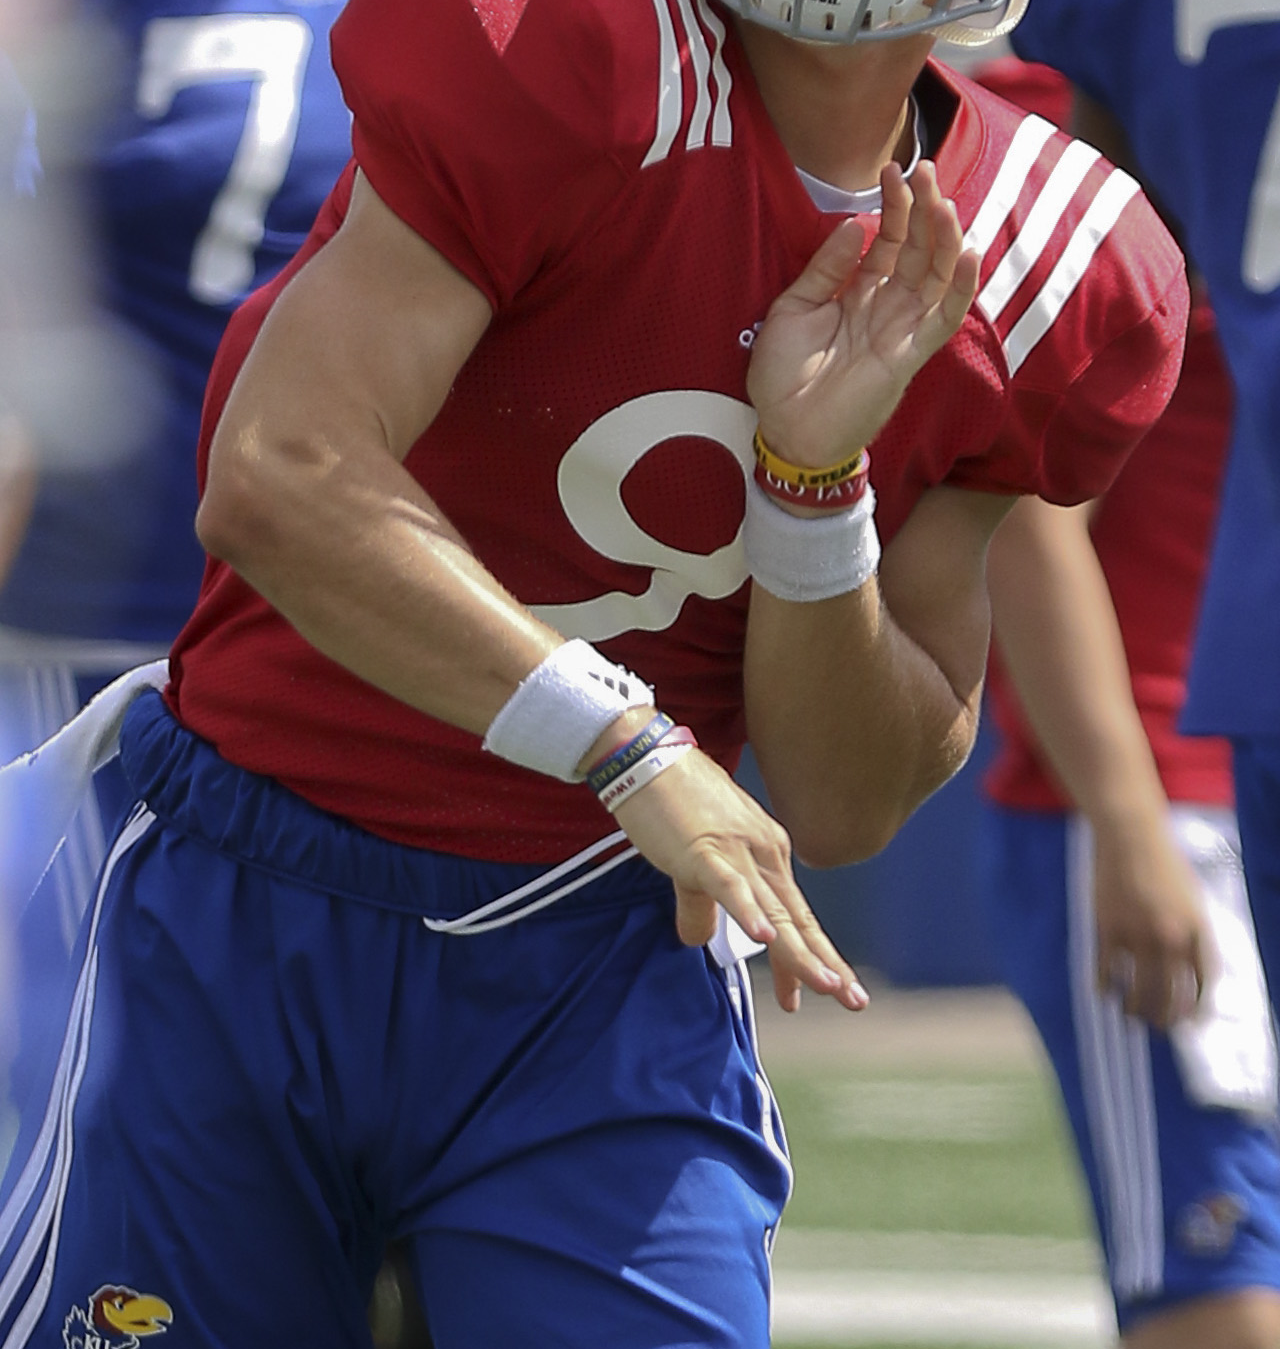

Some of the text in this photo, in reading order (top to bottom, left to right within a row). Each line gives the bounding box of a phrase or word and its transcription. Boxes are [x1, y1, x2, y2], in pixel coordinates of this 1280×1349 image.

[136, 13, 313, 307] 7
[524, 389, 759, 642] 9
[622, 732, 653, 764] NAVY
